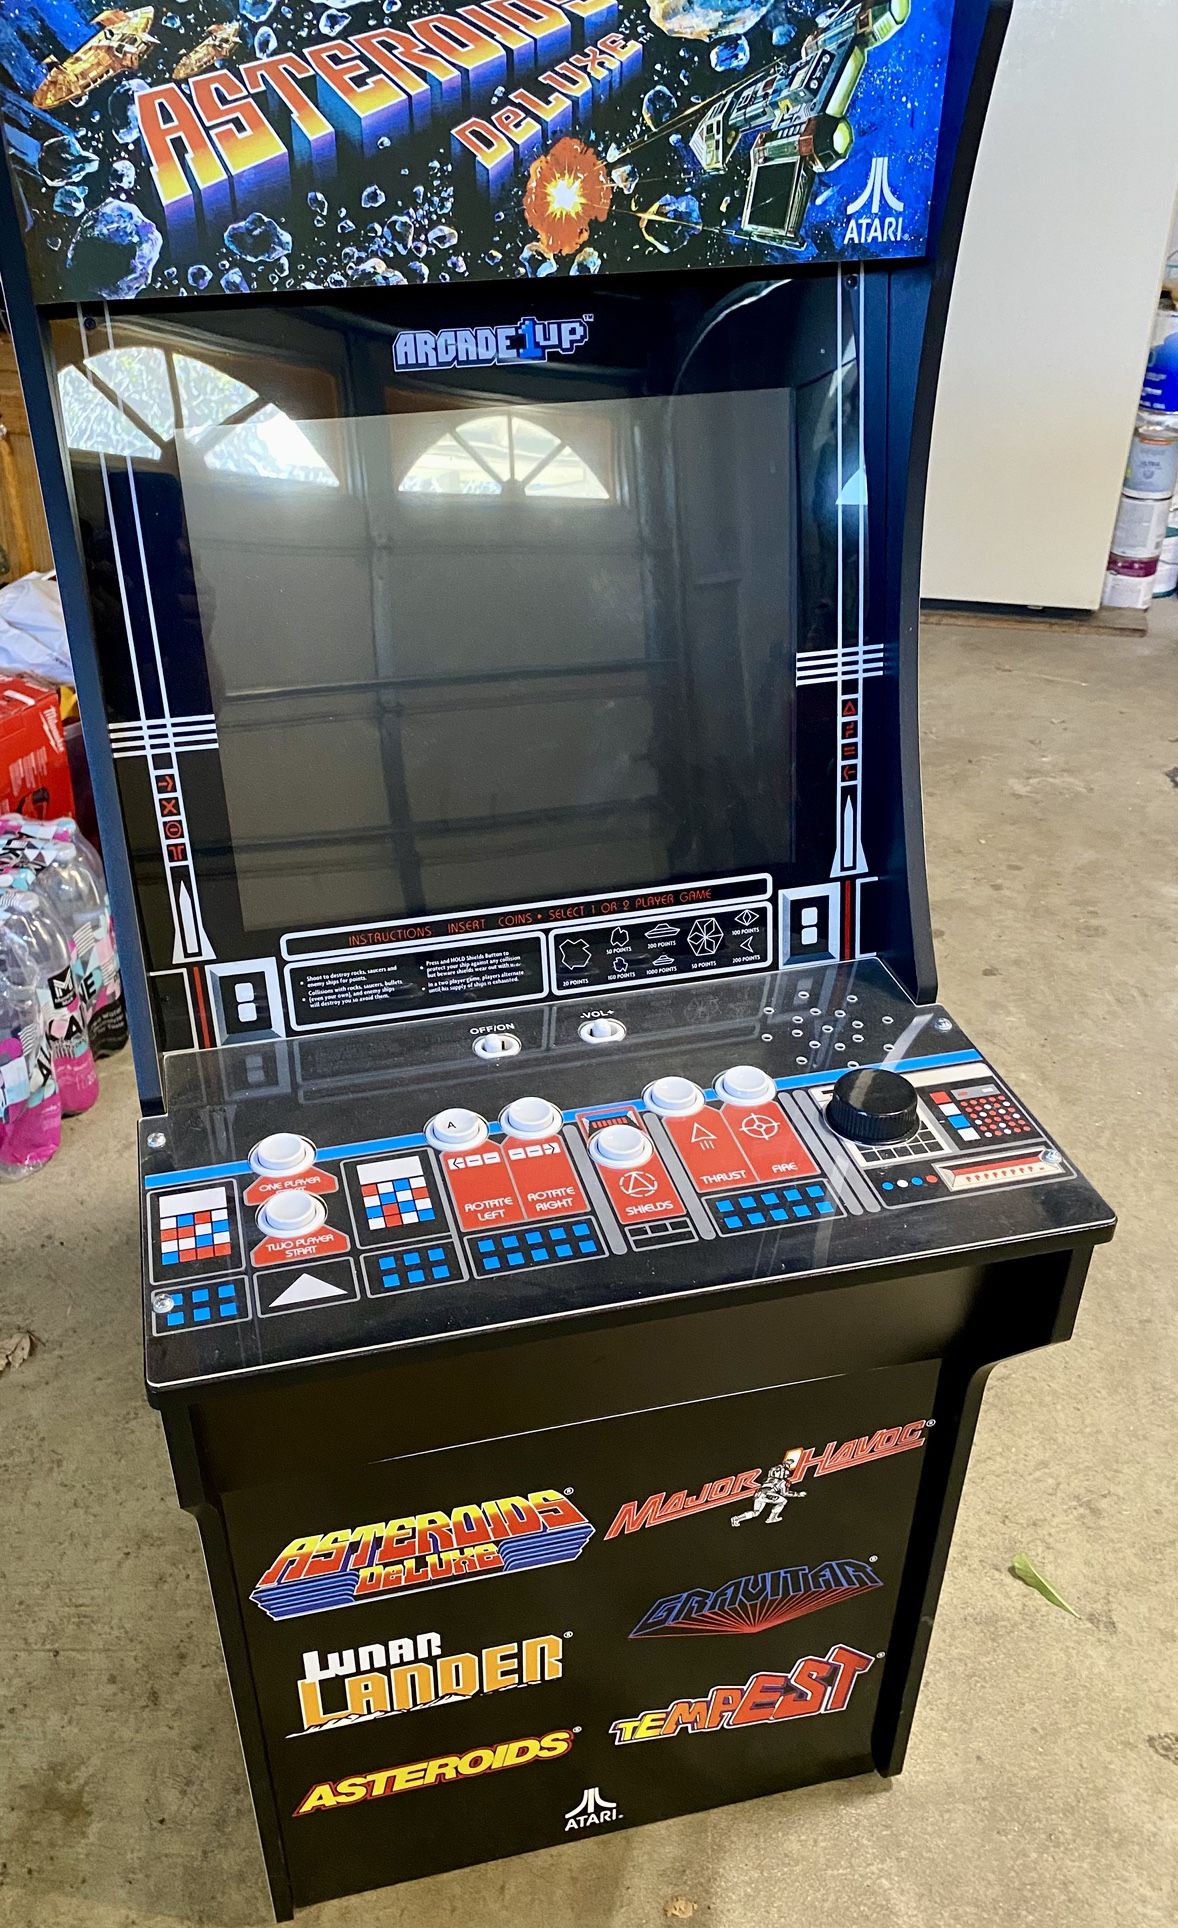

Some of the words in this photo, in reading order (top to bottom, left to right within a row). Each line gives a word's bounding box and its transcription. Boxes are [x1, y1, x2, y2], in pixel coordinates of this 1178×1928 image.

[844, 217, 903, 244] ATARI
[349, 926, 432, 945] INSTRUCTIONS
[448, 919, 486, 933] INSERT
[498, 913, 532, 927] COINS
[549, 905, 584, 920] SELECT
[601, 901, 618, 913] OR
[623, 900, 629, 910] 2
[635, 894, 674, 907] PLAYER
[680, 889, 712, 903] GAME
[470, 1023, 515, 1035] OFF/ON
[772, 1162, 798, 1173] FIRE
[259, 1182, 283, 1192] ONE
[284, 1176, 321, 1188] PLAYER
[700, 1170, 746, 1185] THRUST
[527, 1187, 575, 1201] ROTATE
[465, 1197, 513, 1212] ROTATE
[535, 1199, 573, 1211] RIGHT
[625, 1201, 673, 1216] SHIELDS
[478, 1210, 505, 1221] LEFT
[266, 1240, 294, 1251] TWO
[296, 1234, 334, 1247] PLAYER
[285, 1246, 317, 1258] START
[603, 1467, 762, 1540] MAJOR
[790, 1419, 927, 1484] HAVOC
[255, 1489, 590, 1587] ASTEROIDS
[628, 1559, 884, 1638] GRAVITAR
[302, 1632, 441, 1684] LUNAR
[297, 1635, 563, 1730] LANDER
[609, 1643, 875, 1745] TEMPEST
[293, 1729, 573, 1817] ASTEROIDS
[565, 1808, 617, 1831] ATARI
